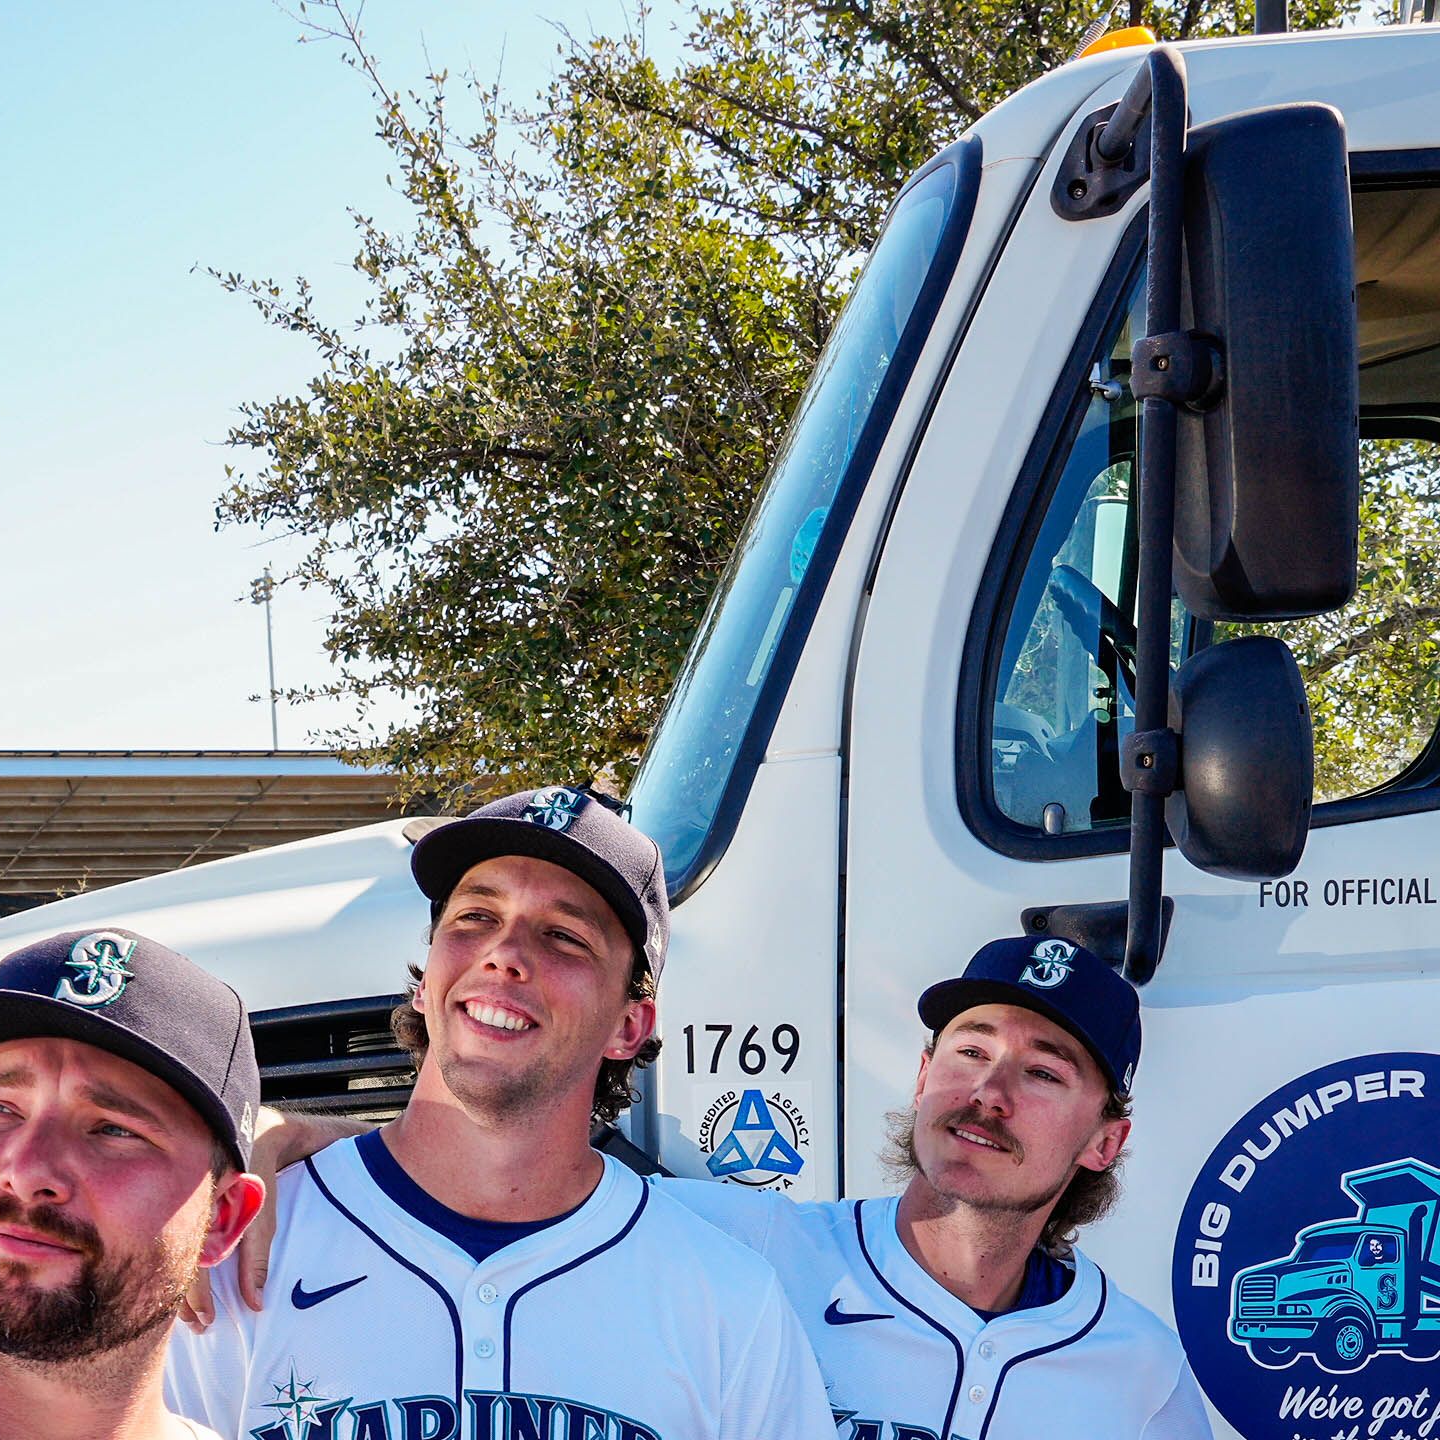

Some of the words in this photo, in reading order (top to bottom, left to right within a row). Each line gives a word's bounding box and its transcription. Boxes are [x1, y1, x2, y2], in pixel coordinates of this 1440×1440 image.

[1259, 880, 1309, 908] FOR
[1323, 877, 1437, 905] OFFICIAL
[682, 1023, 800, 1075] 1769
[699, 1091, 736, 1154] ACCREDITED
[772, 1092, 809, 1147] AGENCY
[1191, 1202, 1231, 1288] BIG
[1218, 1070, 1425, 1193] DUMPER
[1279, 1384, 1364, 1420] We've
[1368, 1388, 1431, 1435] got
